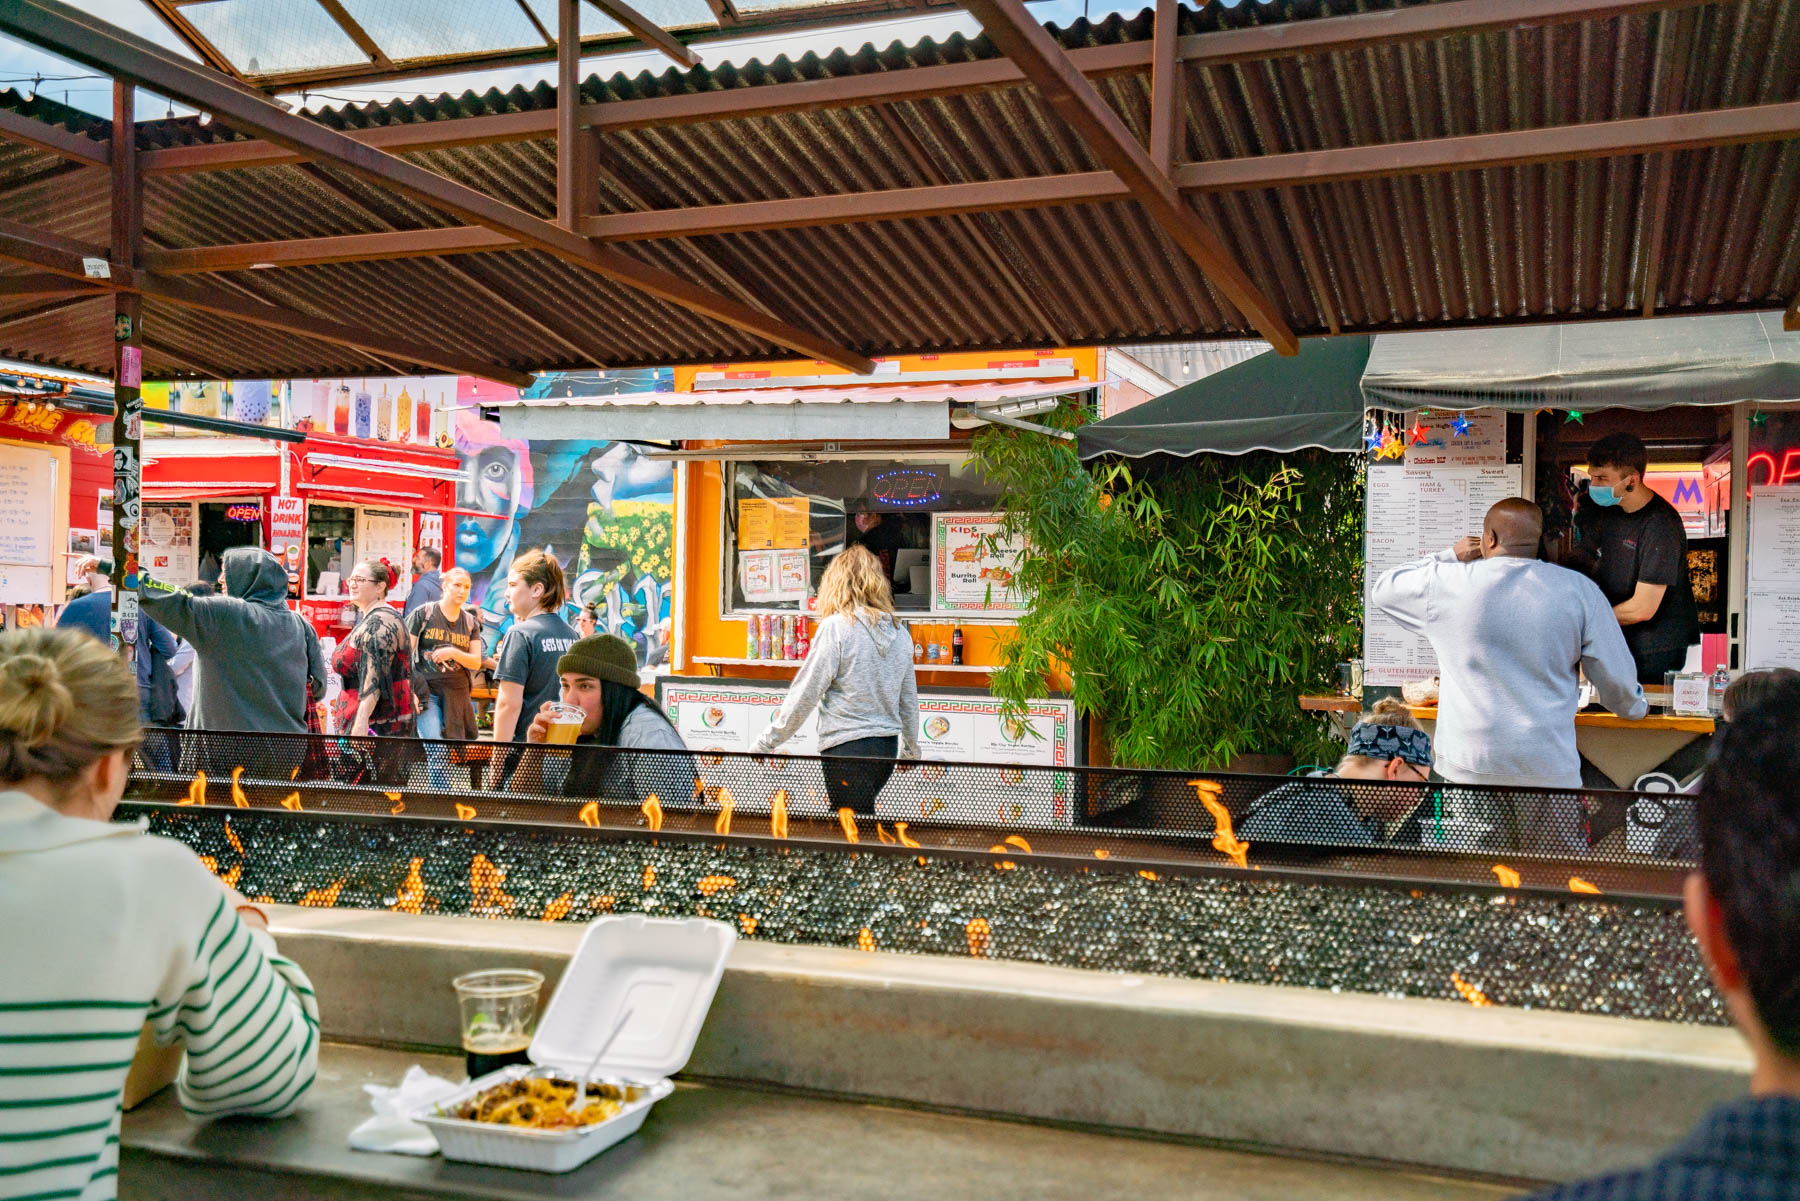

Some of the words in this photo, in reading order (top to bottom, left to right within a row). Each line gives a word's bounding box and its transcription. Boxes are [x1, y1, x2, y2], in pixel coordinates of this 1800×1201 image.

[873, 477, 944, 498] OPEN
[278, 499, 297, 510] HOT
[227, 507, 261, 520] OPEN
[272, 512, 302, 524] DRINK
[425, 628, 444, 641] GUNS
[451, 632, 470, 648] ROSES
[1407, 667, 1440, 675] FREE/VEG
